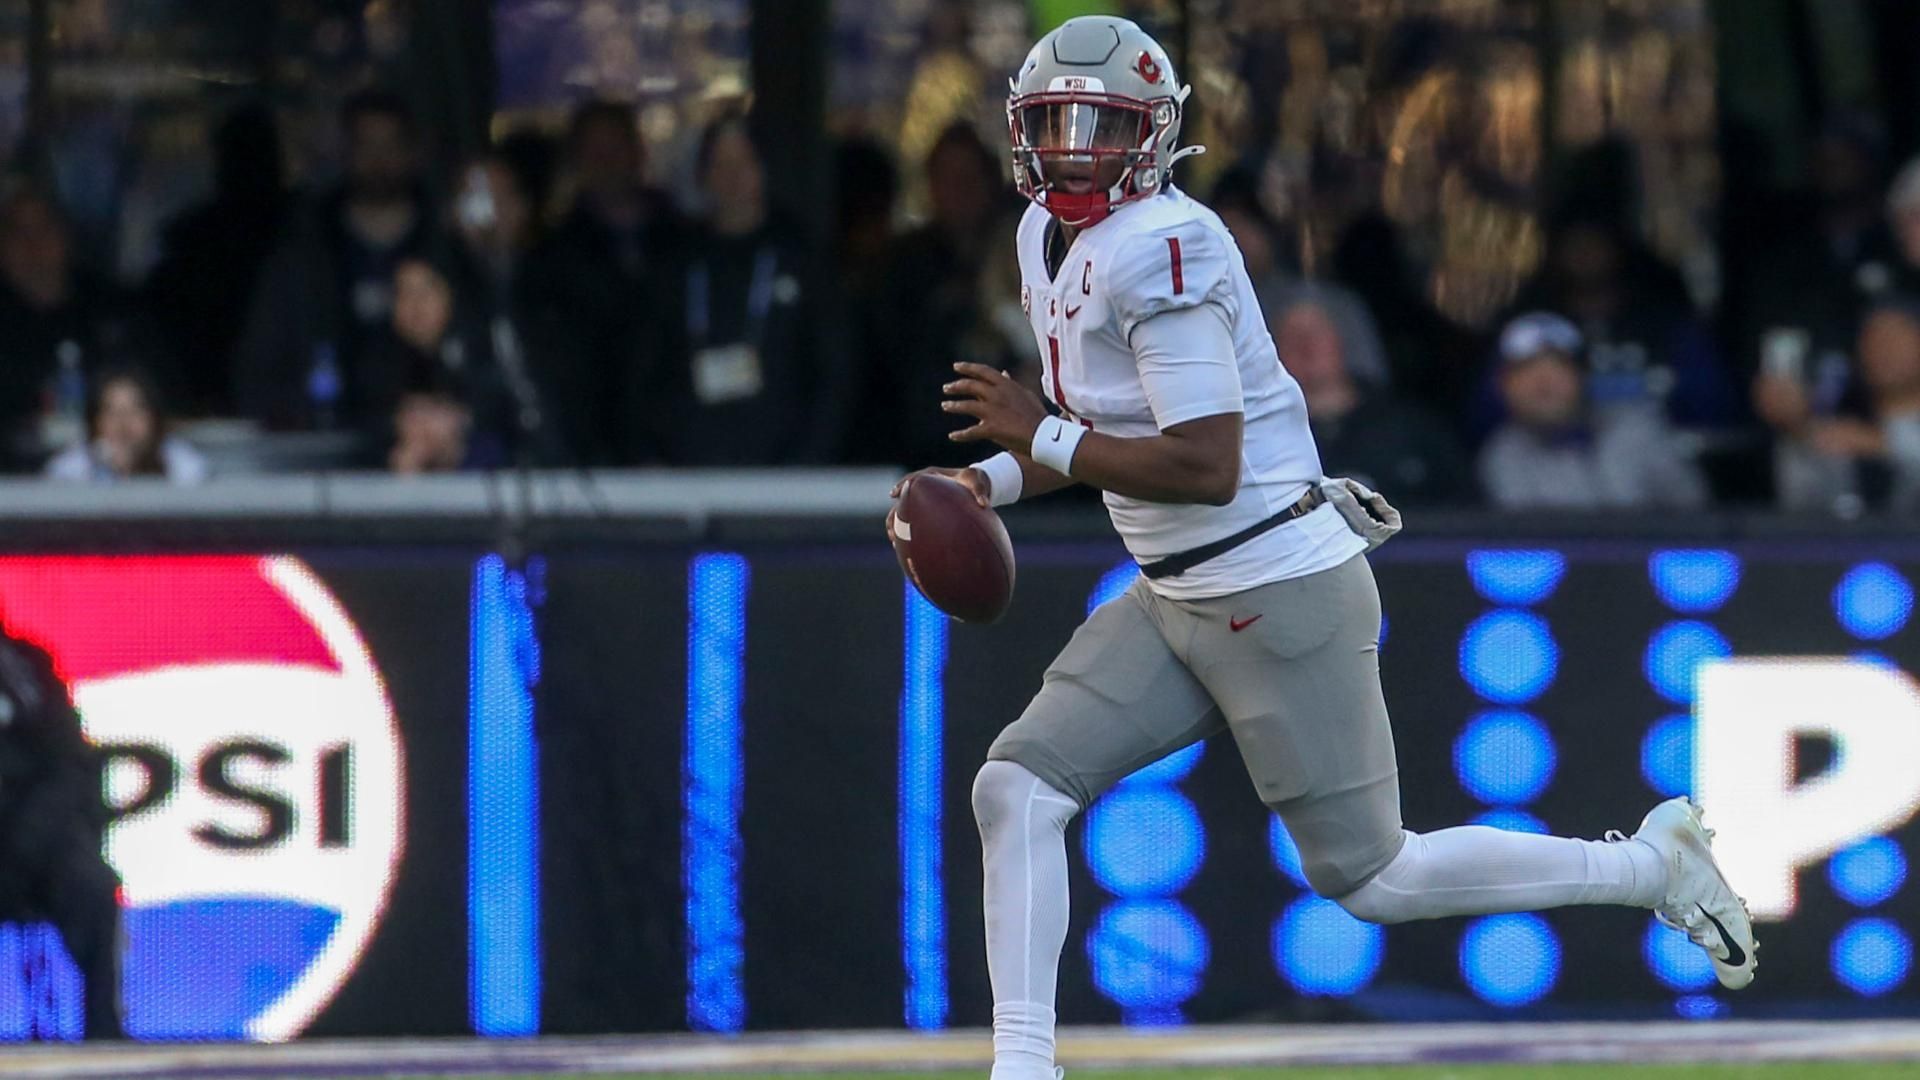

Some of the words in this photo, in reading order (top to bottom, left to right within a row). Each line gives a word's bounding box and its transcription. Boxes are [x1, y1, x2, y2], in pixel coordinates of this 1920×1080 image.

[1064, 77, 1087, 89] WSU
[1082, 260, 1092, 296] C
[1164, 237, 1184, 296] 1
[1691, 656, 1920, 922] P
